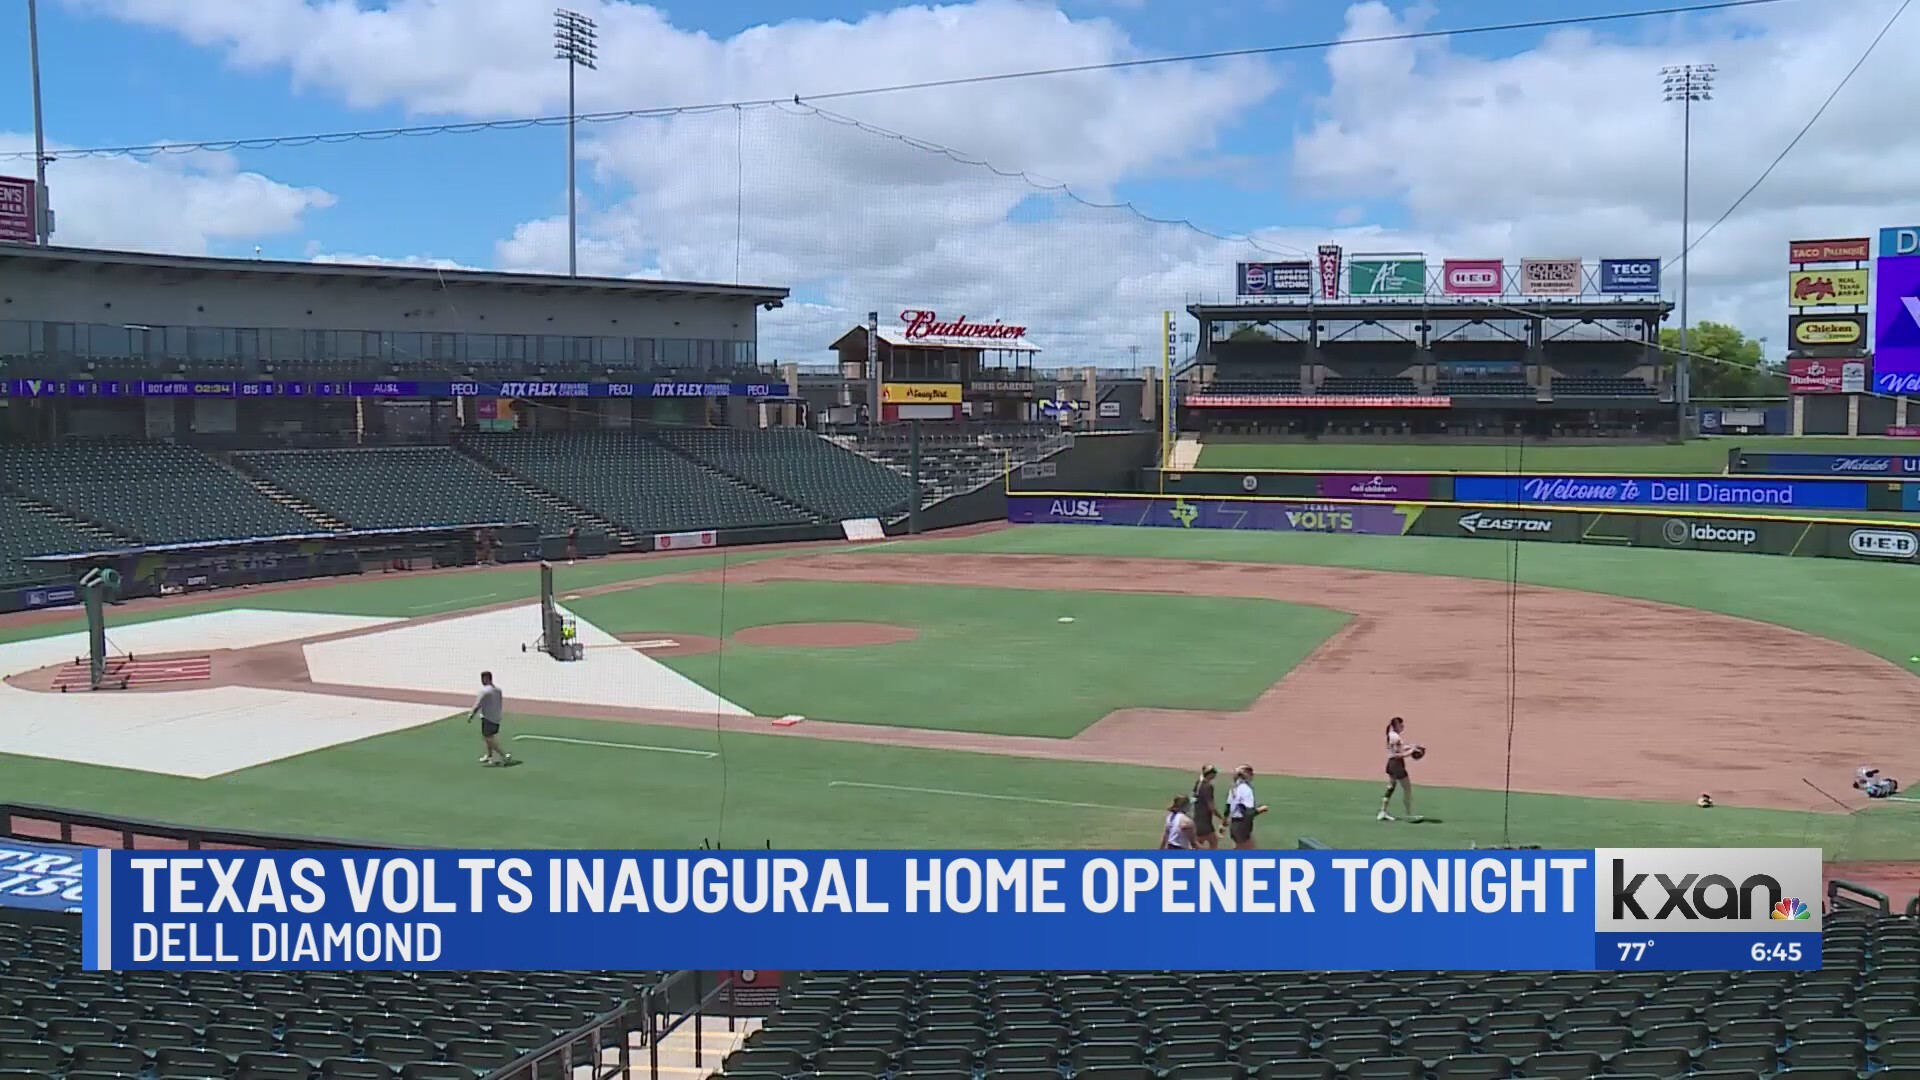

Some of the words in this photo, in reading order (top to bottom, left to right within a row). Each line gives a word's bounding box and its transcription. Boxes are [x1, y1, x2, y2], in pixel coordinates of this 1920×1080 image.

[1897, 230, 1920, 254] D
[1793, 249, 1820, 257] TACO
[1527, 263, 1577, 273] GOLDEN
[1611, 264, 1651, 274] TECO
[1530, 271, 1571, 280] CHICK
[901, 310, 1027, 339] Budweiser
[1806, 325, 1853, 333] Chicken
[996, 382, 1033, 390] GARDEN
[1790, 375, 1841, 386] Budweiser
[374, 384, 399, 393] AUSL
[451, 383, 479, 395] PECU
[501, 383, 525, 396] ATX
[528, 383, 557, 396] FLEX
[608, 384, 633, 395] PECU
[652, 384, 674, 396] ATX
[676, 384, 702, 396] FLEX
[747, 385, 769, 395] PECU
[1904, 460, 1920, 472] U
[1524, 476, 1615, 500] Welcome
[1619, 480, 1640, 500] to
[1651, 483, 1689, 502] Dell
[1698, 483, 1793, 504] Diamond
[1051, 500, 1100, 516] AUSL
[1285, 511, 1353, 529] VOLTS
[1476, 518, 1552, 531] EASTON
[1691, 524, 1756, 545] labcorp
